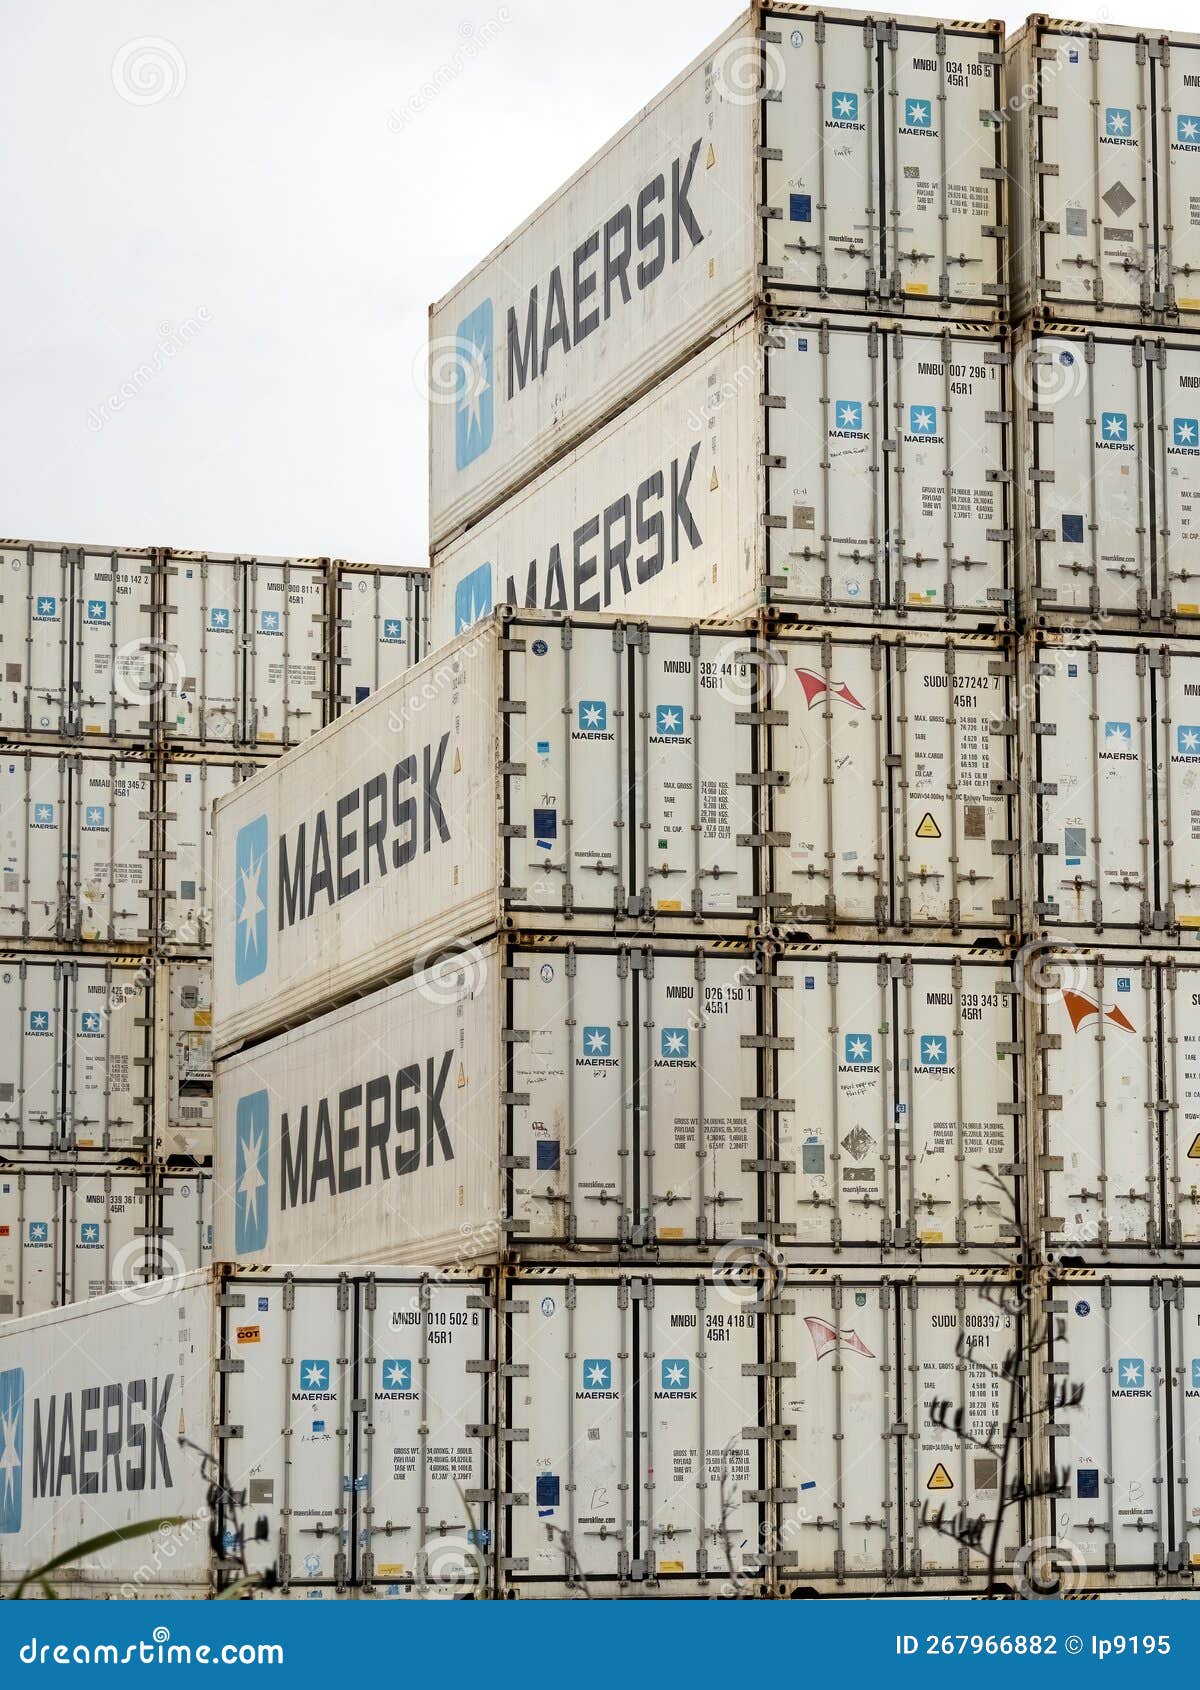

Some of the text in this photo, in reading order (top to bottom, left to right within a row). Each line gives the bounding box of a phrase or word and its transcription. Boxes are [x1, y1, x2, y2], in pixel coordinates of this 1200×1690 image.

[913, 58, 991, 77] MNBU 034 186 5
[947, 75, 969, 87] 45R1
[825, 121, 865, 131] MAERSK
[899, 127, 939, 138] MAERSK
[1100, 137, 1138, 147] MAERSK
[829, 235, 864, 244] maerskline.com
[507, 137, 704, 401] MAERSK
[918, 362, 944, 375] MNBU
[949, 365, 966, 377] 007
[970, 366, 986, 379] 296
[951, 382, 972, 395] 45R1
[829, 430, 870, 440] MAERSK
[904, 435, 944, 444] MAERSK
[1096, 441, 1135, 451] MAERSK
[833, 536, 868, 545] maerskline.com
[1101, 555, 1135, 563] maerskline.com
[94, 573, 113, 582] MNBU
[116, 574, 129, 583] 910
[131, 575, 143, 584] 142
[116, 586, 132, 595] 45R1
[267, 582, 285, 592] MNBU
[288, 584, 300, 594] 900
[302, 584, 314, 594] 811
[288, 595, 304, 605] 45R1
[83, 619, 111, 627] MAERSK
[664, 660, 691, 674] MNBU
[700, 662, 717, 675] 382
[721, 663, 738, 676] 441
[700, 676, 723, 689] 45R1
[924, 676, 948, 688] SUDU
[952, 677, 988, 689] 627242
[954, 695, 977, 708] 45R1
[572, 731, 614, 741] MAERSK
[649, 736, 692, 745] MAERSK
[1099, 752, 1138, 761] MAERSK
[89, 778, 110, 787] MMAU
[114, 780, 126, 789] 108
[128, 781, 140, 789] 345
[114, 788, 130, 797] 45R1
[278, 731, 451, 932] MAERSK
[575, 851, 612, 859] maerskline.com
[1104, 869, 1139, 877] maersline.com
[88, 985, 106, 994] MNBU
[111, 986, 122, 995] 425
[666, 986, 694, 999] MNBU
[705, 987, 723, 1000] 026
[727, 988, 743, 1001] 150
[927, 993, 953, 1006] MNBU
[961, 994, 978, 1007] 339
[982, 994, 998, 1007] 343
[705, 1002, 728, 1014] 45R1
[962, 1008, 982, 1021] 45R1
[575, 1058, 619, 1067] MAERSK
[654, 1059, 696, 1068] MAERSK
[838, 1065, 880, 1074] MAERSK
[914, 1066, 955, 1075] MAERSK
[280, 1049, 454, 1211] MAERSK
[578, 1181, 615, 1189] maerskline.com
[842, 1185, 878, 1194] maerskline.com
[86, 1195, 105, 1203] MNBU
[110, 1196, 122, 1204] 339
[124, 1196, 136, 1204] 361
[111, 1205, 124, 1213] 45R1
[392, 1312, 421, 1325] MNBU
[427, 1313, 445, 1326] 010
[449, 1312, 468, 1326] 502
[671, 1315, 697, 1327] MNBU
[706, 1315, 724, 1328] 349
[727, 1315, 745, 1328] 418
[931, 1315, 956, 1328] SUDU
[965, 1315, 1000, 1328] 808397
[237, 1330, 259, 1340] COT
[428, 1331, 452, 1344] 45R1
[707, 1329, 730, 1341] 45R1
[291, 1393, 337, 1401] MAERSK
[374, 1392, 420, 1400] MAERSK
[575, 1391, 620, 1400] MAERSK
[654, 1391, 697, 1400] MAERSK
[1112, 1390, 1152, 1398] MAERSK
[32, 1374, 174, 1498] MAERSK
[293, 1509, 332, 1518] maerskline.com
[1118, 1508, 1153, 1516] maerskline.com
[578, 1516, 615, 1524] maerskline.com
